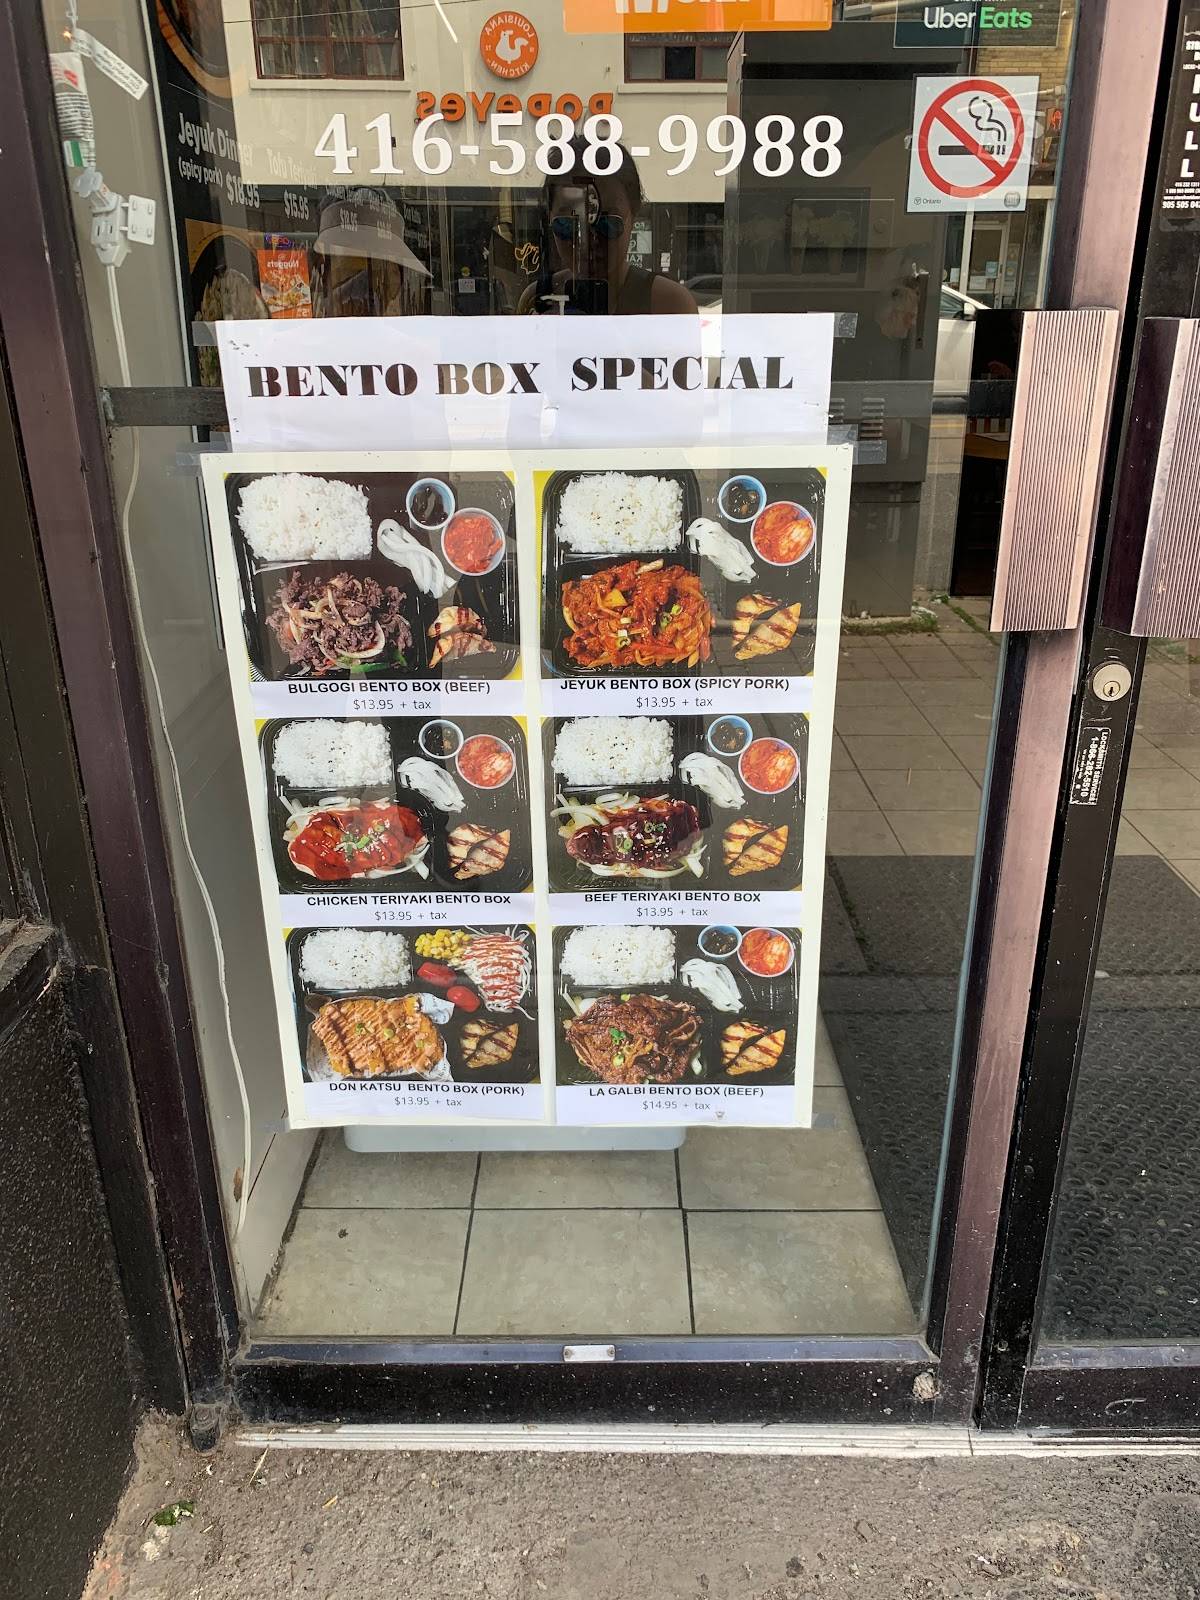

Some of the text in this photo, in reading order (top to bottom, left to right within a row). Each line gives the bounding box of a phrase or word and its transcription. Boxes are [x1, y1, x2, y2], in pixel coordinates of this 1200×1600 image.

[924, 7, 1033, 29] Uber Eats
[178, 112, 216, 155] Jeyuk
[314, 112, 844, 178] 416-588-9988
[178, 156, 223, 188] (spicy pork)
[245, 355, 794, 398] BENTO BOX SPECIAL
[288, 681, 491, 694] BULGOGI BENTO BOX (BEEF)
[560, 678, 790, 691] JEYUK BENTO BOX (SPICY PORK)
[353, 698, 394, 711] $13.95
[413, 700, 432, 710] tax
[636, 696, 676, 709] $13.95
[695, 697, 713, 707] tax
[1089, 731, 1109, 802] LOCKSMITH SERVICES
[307, 894, 512, 906] CHICKEN TERIYAKI BENTO BOX
[584, 892, 761, 902] BEEF TERIYAKI BENTO BOX
[374, 910, 448, 922] $13.95 + tax
[636, 906, 674, 918] $13.95
[692, 907, 708, 917] tax
[329, 1082, 525, 1096] DON KATSU BENTO BOX (PORK)
[589, 1086, 764, 1098] LA GALBI BENTO BOX (BEEF)
[394, 1096, 430, 1106] $13.95
[446, 1097, 462, 1107] tax
[642, 1100, 678, 1110] $14.95
[694, 1101, 711, 1110] tax
